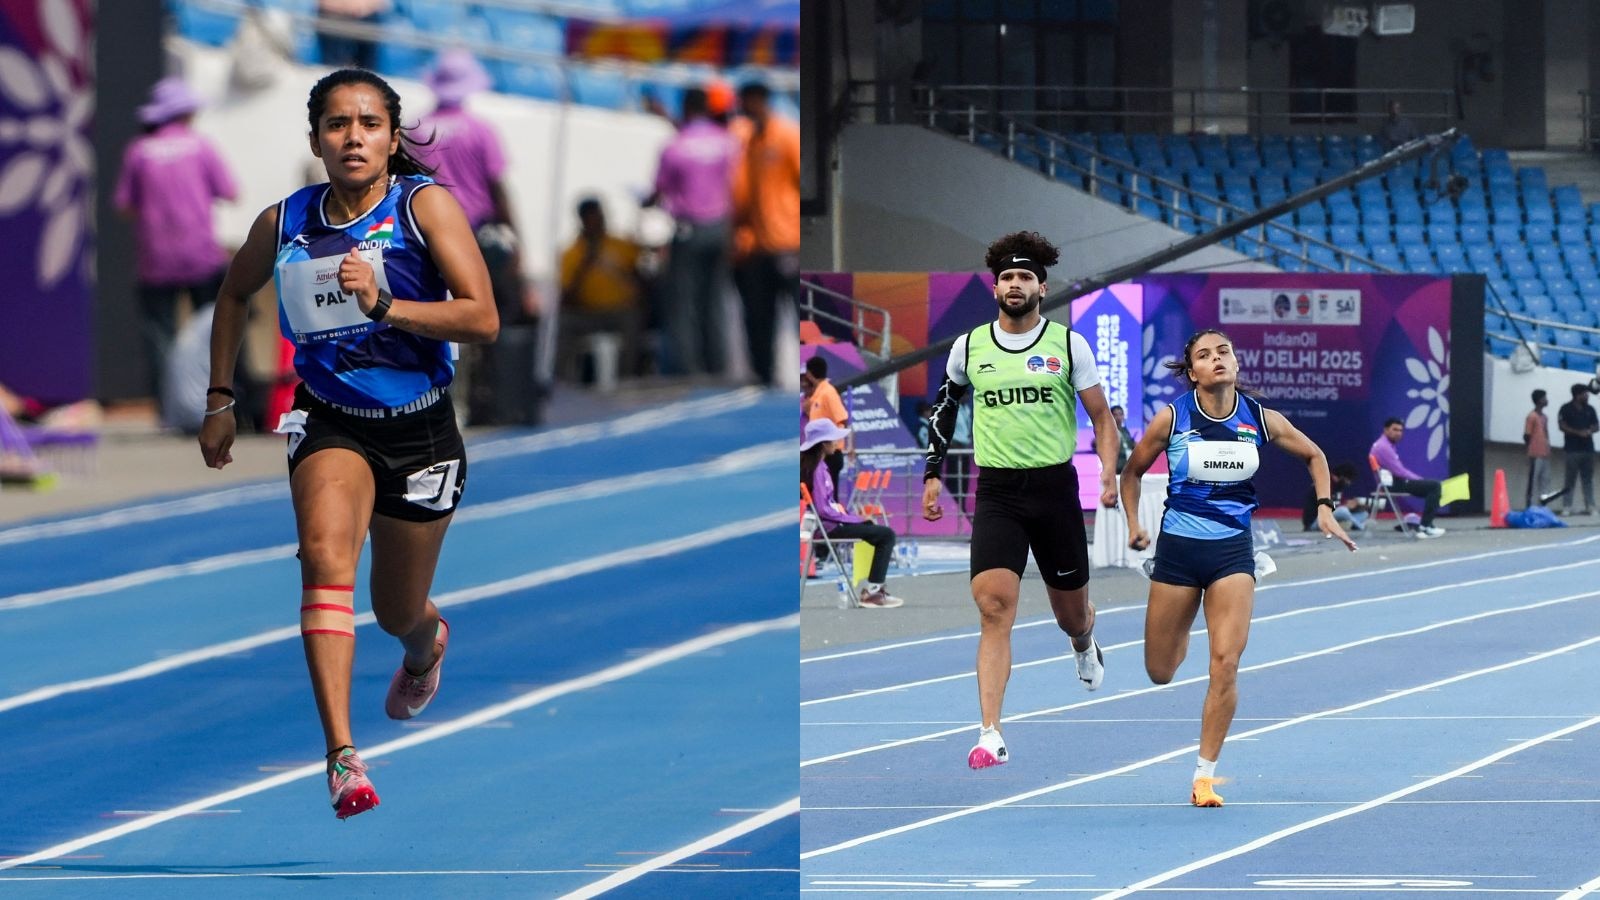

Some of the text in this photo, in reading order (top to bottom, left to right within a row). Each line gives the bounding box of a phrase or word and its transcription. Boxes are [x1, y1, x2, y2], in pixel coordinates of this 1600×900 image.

[358, 239, 392, 250] INDIA
[314, 290, 347, 308] PAL
[351, 326, 368, 334] 2025
[1096, 314, 1110, 362] 2025
[1263, 331, 1318, 347] IndianOil
[1236, 350, 1363, 370] EW DELHI 2025
[1263, 372, 1294, 385] PARA
[1297, 372, 1363, 386] ATHLETICS
[983, 387, 1054, 408] GUIDE
[852, 418, 900, 432] REMONY
[1203, 460, 1244, 470] SIMRAN
